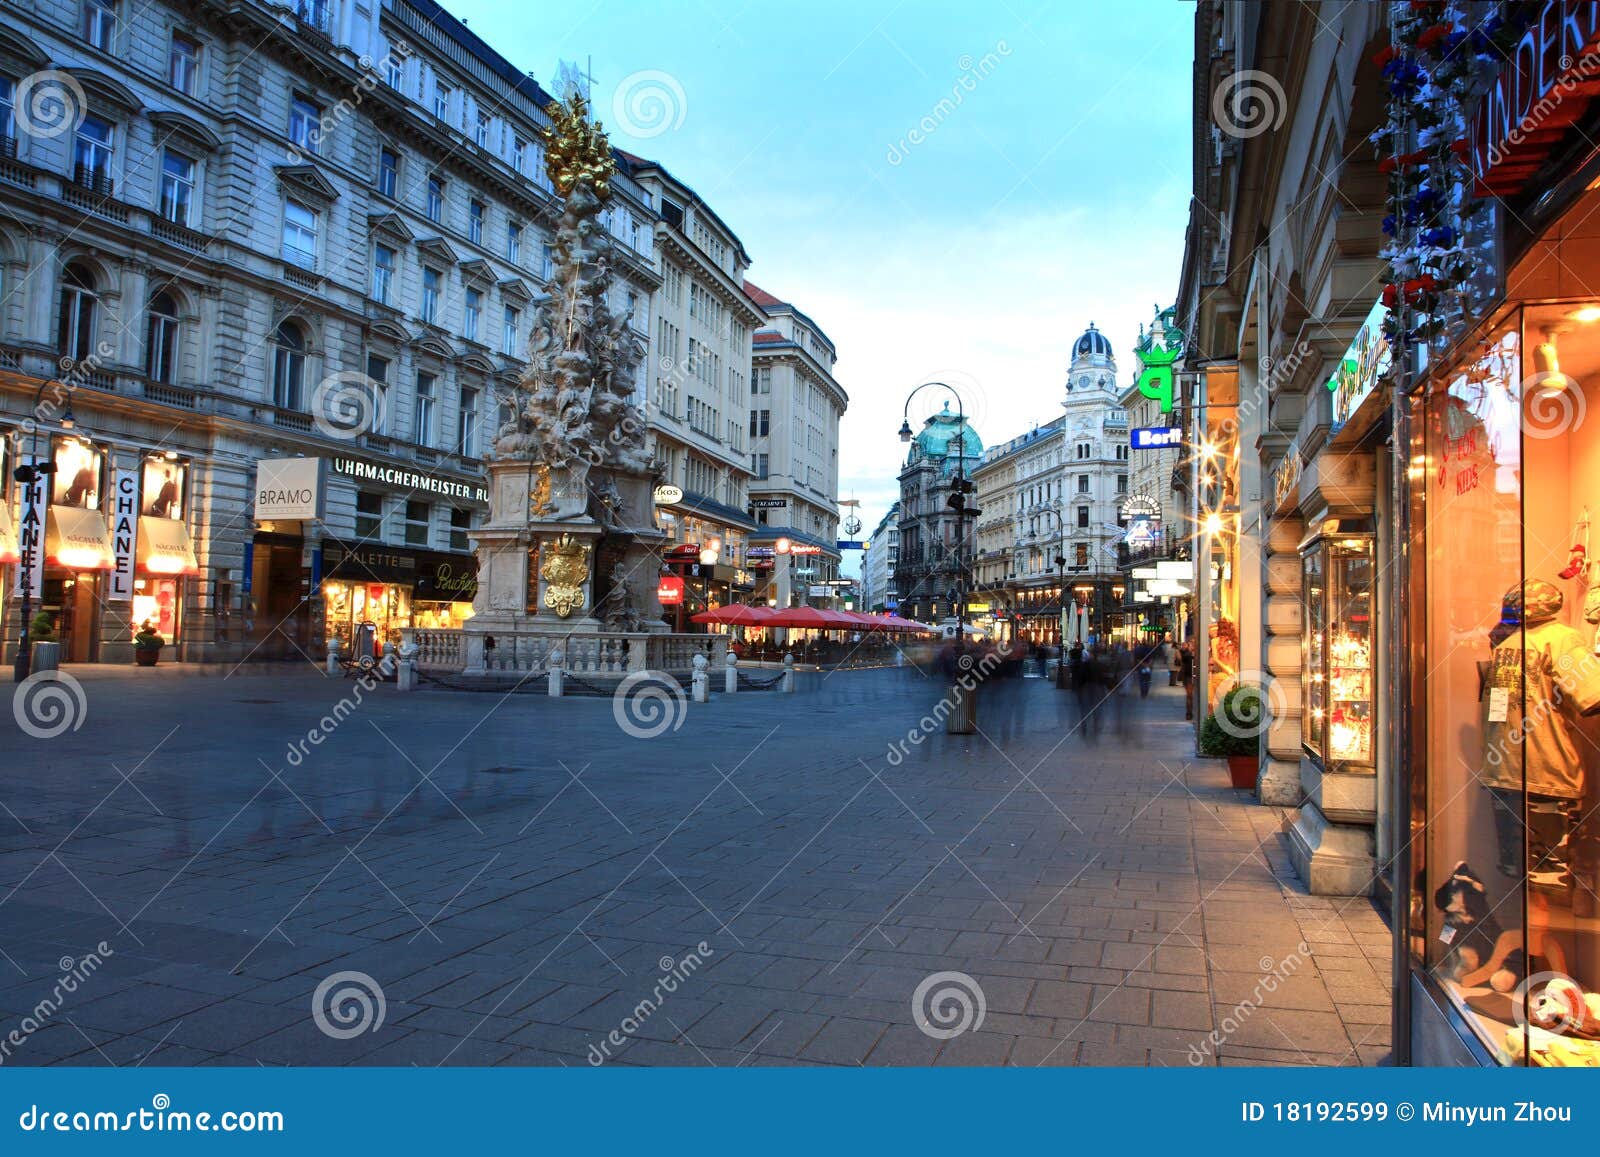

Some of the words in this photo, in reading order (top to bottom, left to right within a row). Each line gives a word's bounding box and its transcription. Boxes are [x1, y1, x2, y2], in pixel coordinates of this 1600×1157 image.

[335, 457, 470, 499] UHRMACHERMEISTER
[1456, 464, 1479, 497] KIDS
[259, 489, 313, 505] BRAMO
[114, 477, 133, 594] CHANEL
[343, 551, 398, 567] PALETTE
